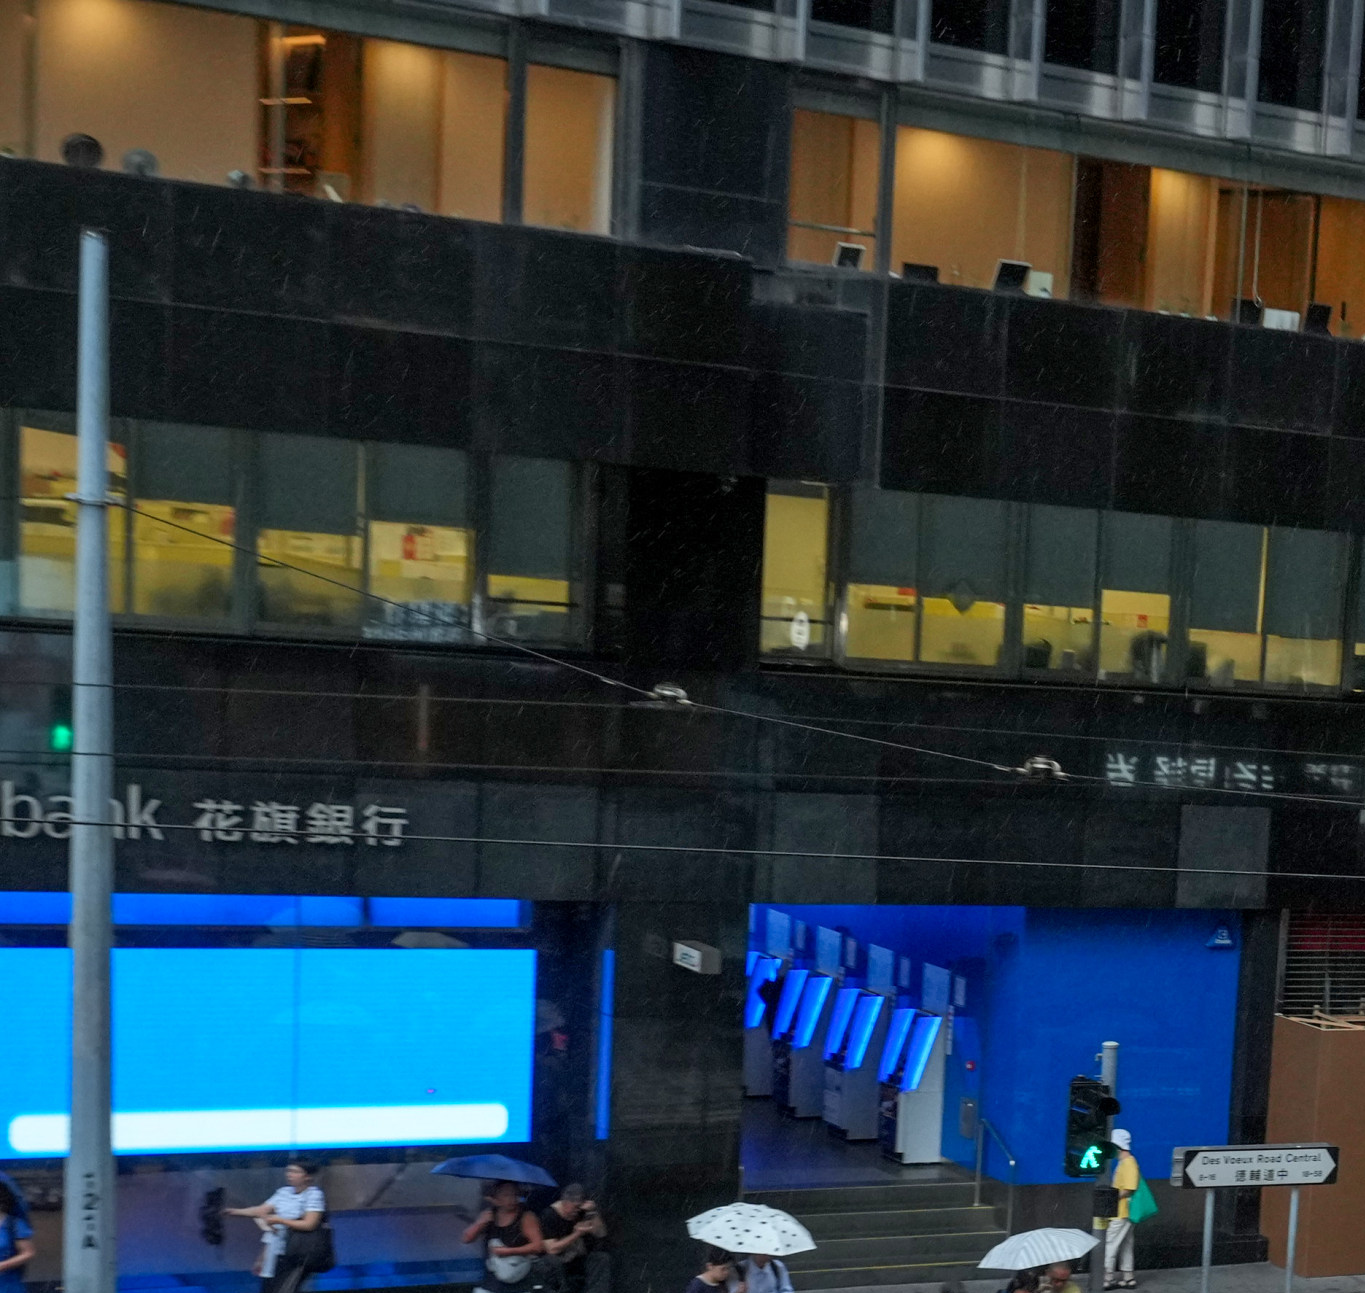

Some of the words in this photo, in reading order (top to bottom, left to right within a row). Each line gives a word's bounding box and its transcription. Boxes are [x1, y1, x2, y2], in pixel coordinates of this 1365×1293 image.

[0, 780, 164, 840] bak
[193, 798, 410, 846] 花旗銀行
[1201, 1155, 1221, 1166] Des
[1223, 1155, 1253, 1165] Voeux
[1257, 1153, 1282, 1164] Road
[1285, 1152, 1322, 1163] Central
